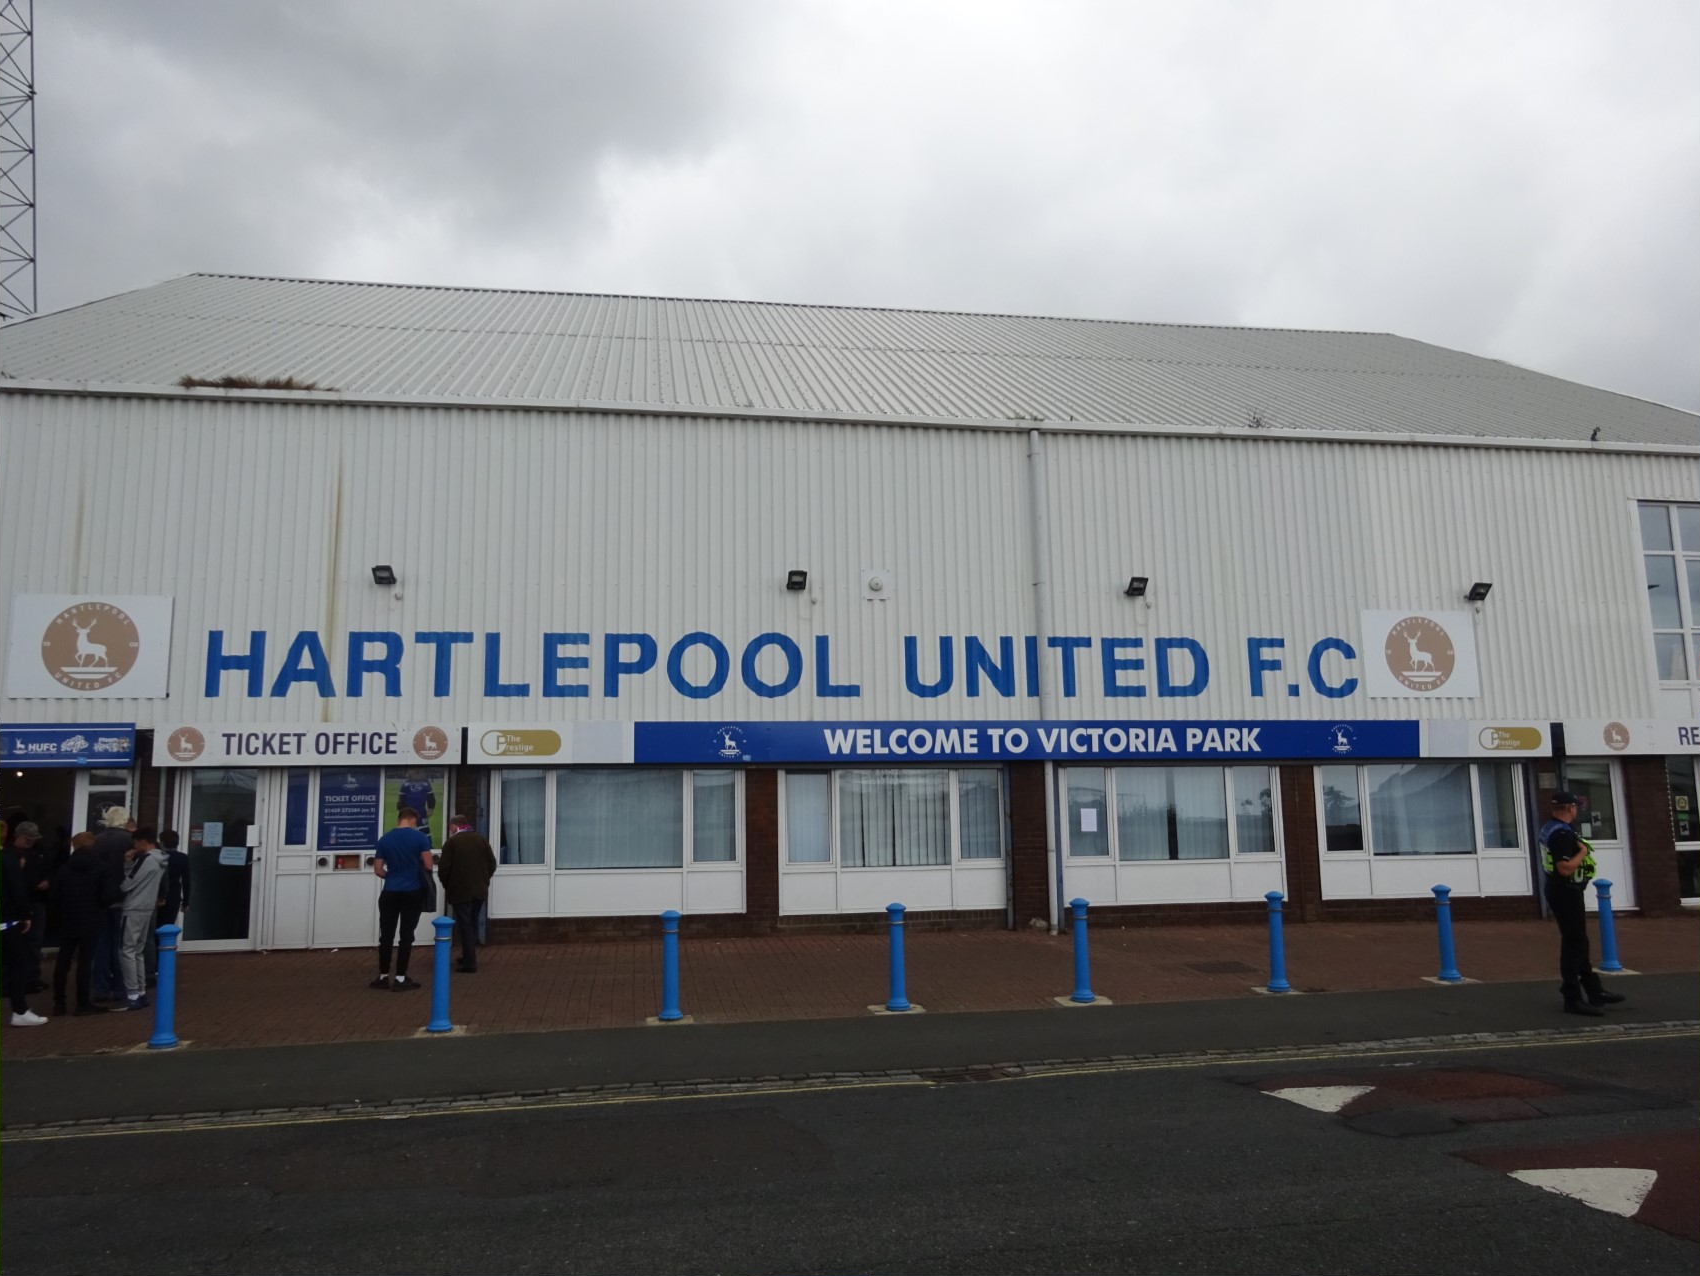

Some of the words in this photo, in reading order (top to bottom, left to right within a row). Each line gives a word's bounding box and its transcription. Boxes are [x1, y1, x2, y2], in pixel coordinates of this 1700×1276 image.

[56, 604, 130, 625] HARTLEPOOL
[204, 630, 861, 699] HARTLEPOOL
[904, 635, 1210, 698] UNITED
[1247, 636, 1359, 699] F.C
[54, 671, 100, 689] UNITED
[108, 672, 122, 684] FC
[28, 743, 57, 751] HUFC
[222, 732, 306, 755] TICKET
[314, 732, 398, 755] OFFICE
[824, 728, 979, 755] WELCOME
[986, 728, 1029, 755] TO
[1037, 728, 1177, 754] VICTORIA
[1186, 727, 1262, 753] PARK
